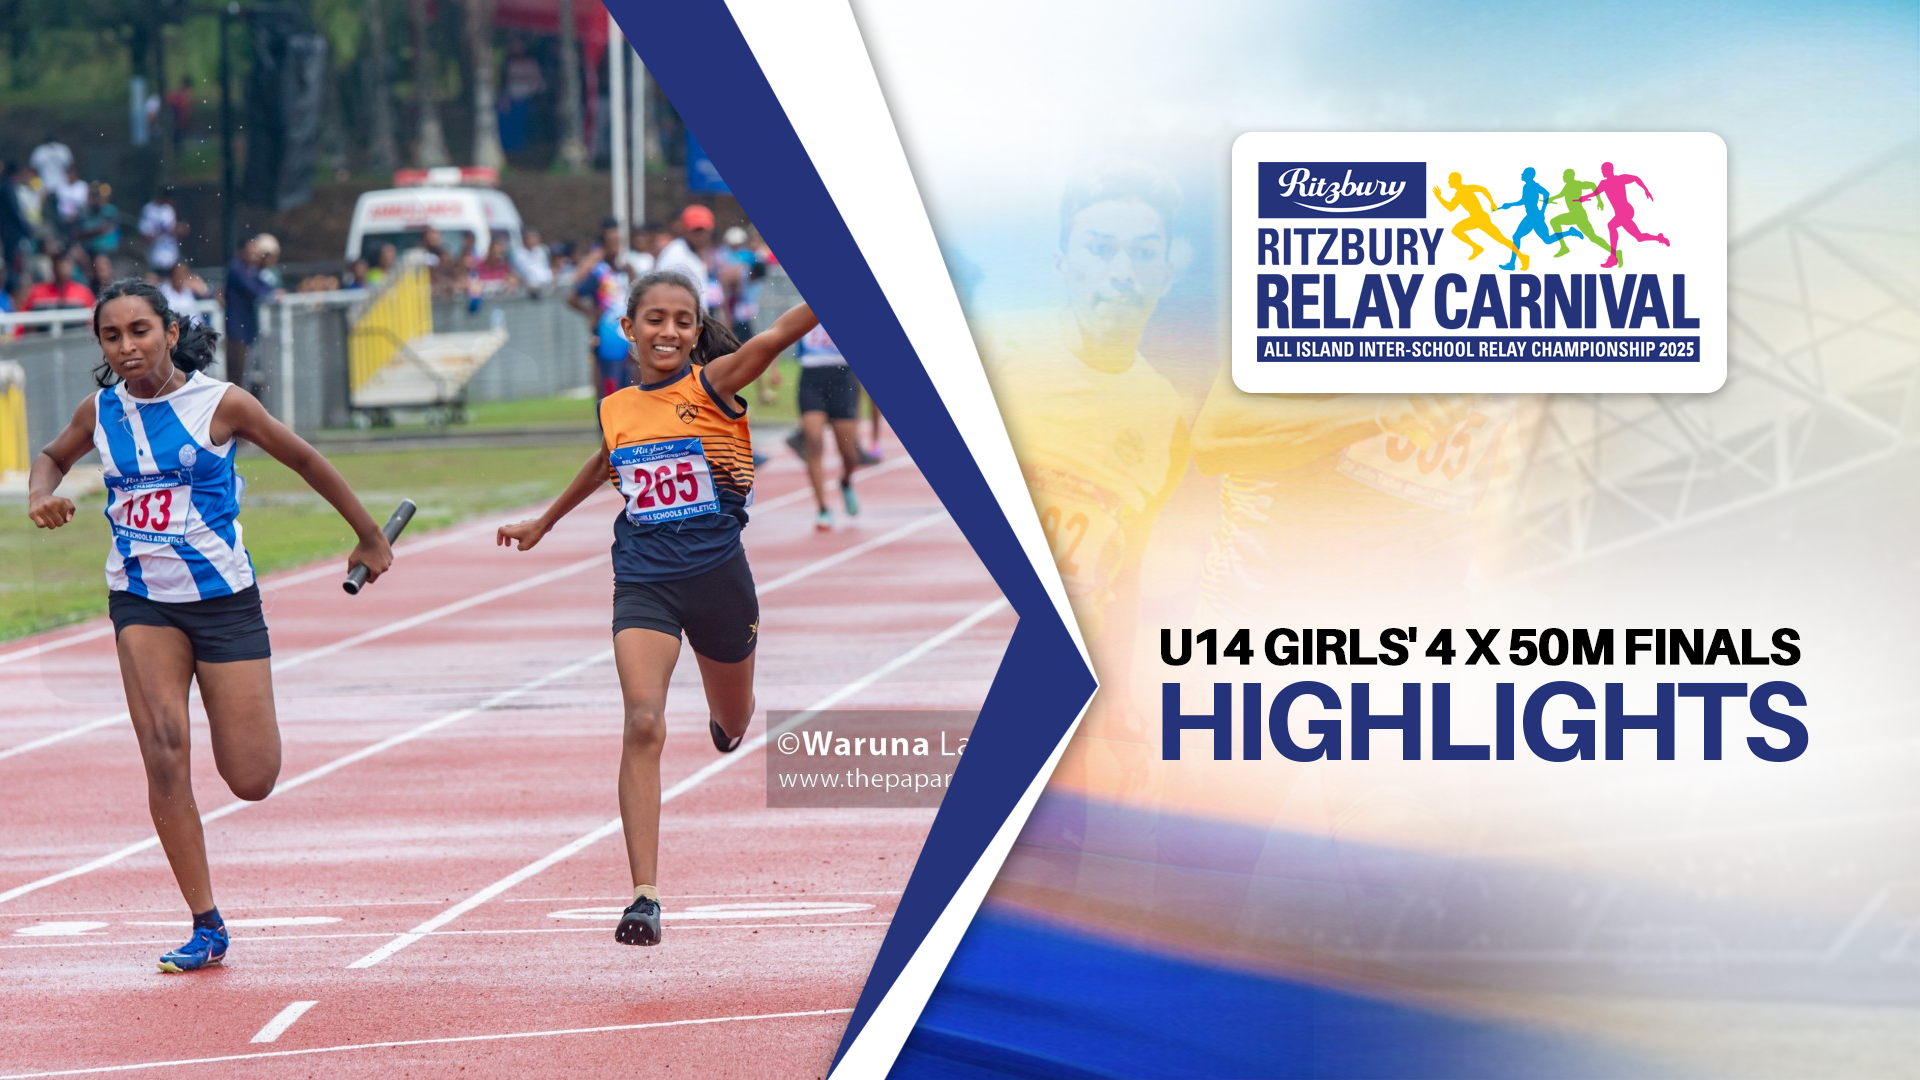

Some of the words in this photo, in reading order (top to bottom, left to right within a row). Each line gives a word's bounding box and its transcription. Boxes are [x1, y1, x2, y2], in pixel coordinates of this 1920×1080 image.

[633, 444, 674, 456] Ritzbury
[634, 462, 698, 509] 265
[122, 489, 172, 531] 133
[653, 509, 682, 520] SCHOOLS
[684, 502, 717, 515] ATHLETICS
[129, 531, 153, 541] SCHOOLS
[153, 535, 184, 544] ATHLETICS
